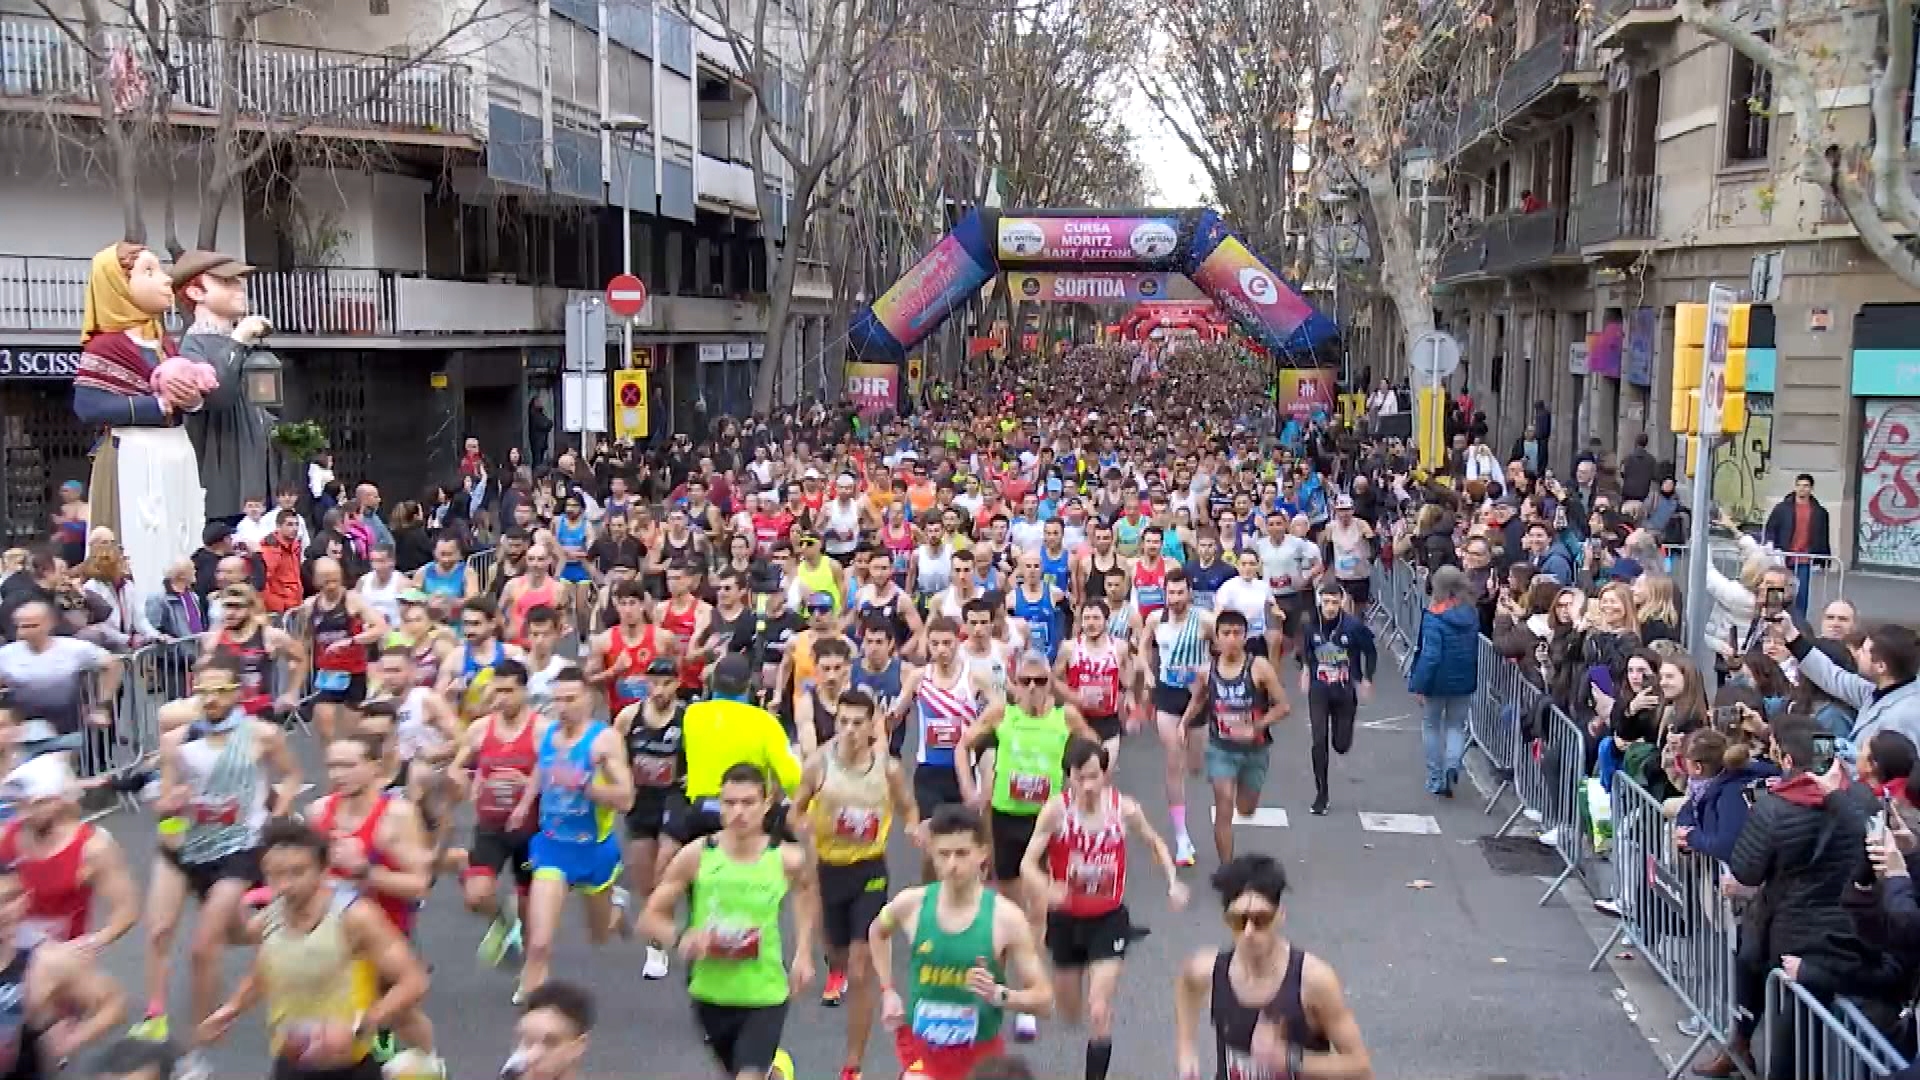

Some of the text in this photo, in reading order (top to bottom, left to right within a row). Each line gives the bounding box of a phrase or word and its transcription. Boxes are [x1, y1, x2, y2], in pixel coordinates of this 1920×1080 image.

[1063, 222, 1111, 233] CURSA
[1061, 235, 1113, 247] MORITZ
[1081, 249, 1132, 260] ANTONI
[1054, 277, 1126, 297] SORTIDA
